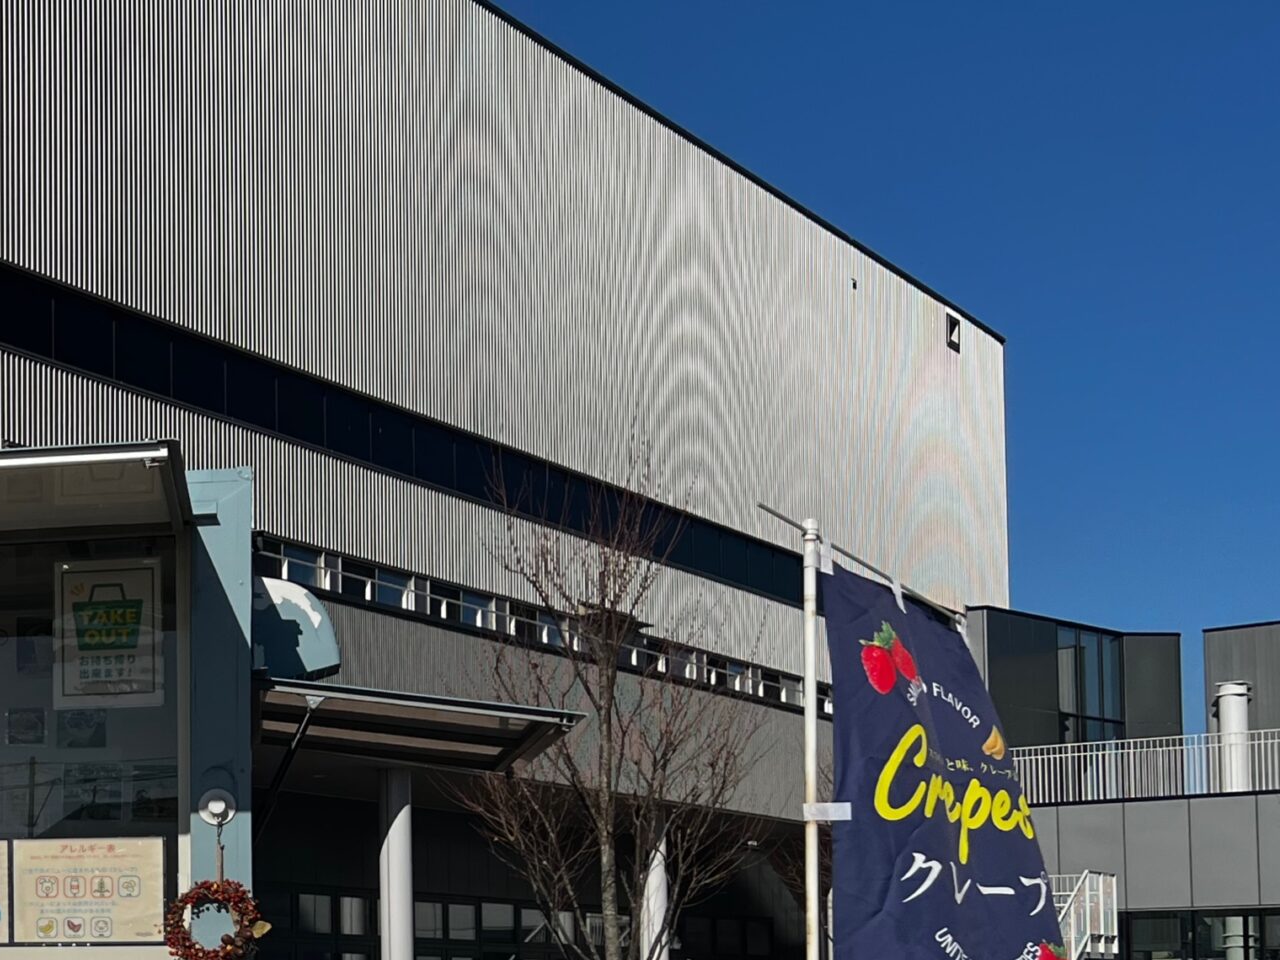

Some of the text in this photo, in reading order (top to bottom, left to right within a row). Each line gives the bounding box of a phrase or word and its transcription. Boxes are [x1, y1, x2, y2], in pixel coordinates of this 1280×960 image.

[79, 608, 137, 624] TAKE
[84, 628, 130, 645] OUT
[931, 681, 981, 729] FLAVOR
[873, 723, 1035, 865] Crepes
[899, 851, 1049, 917] クレープ
